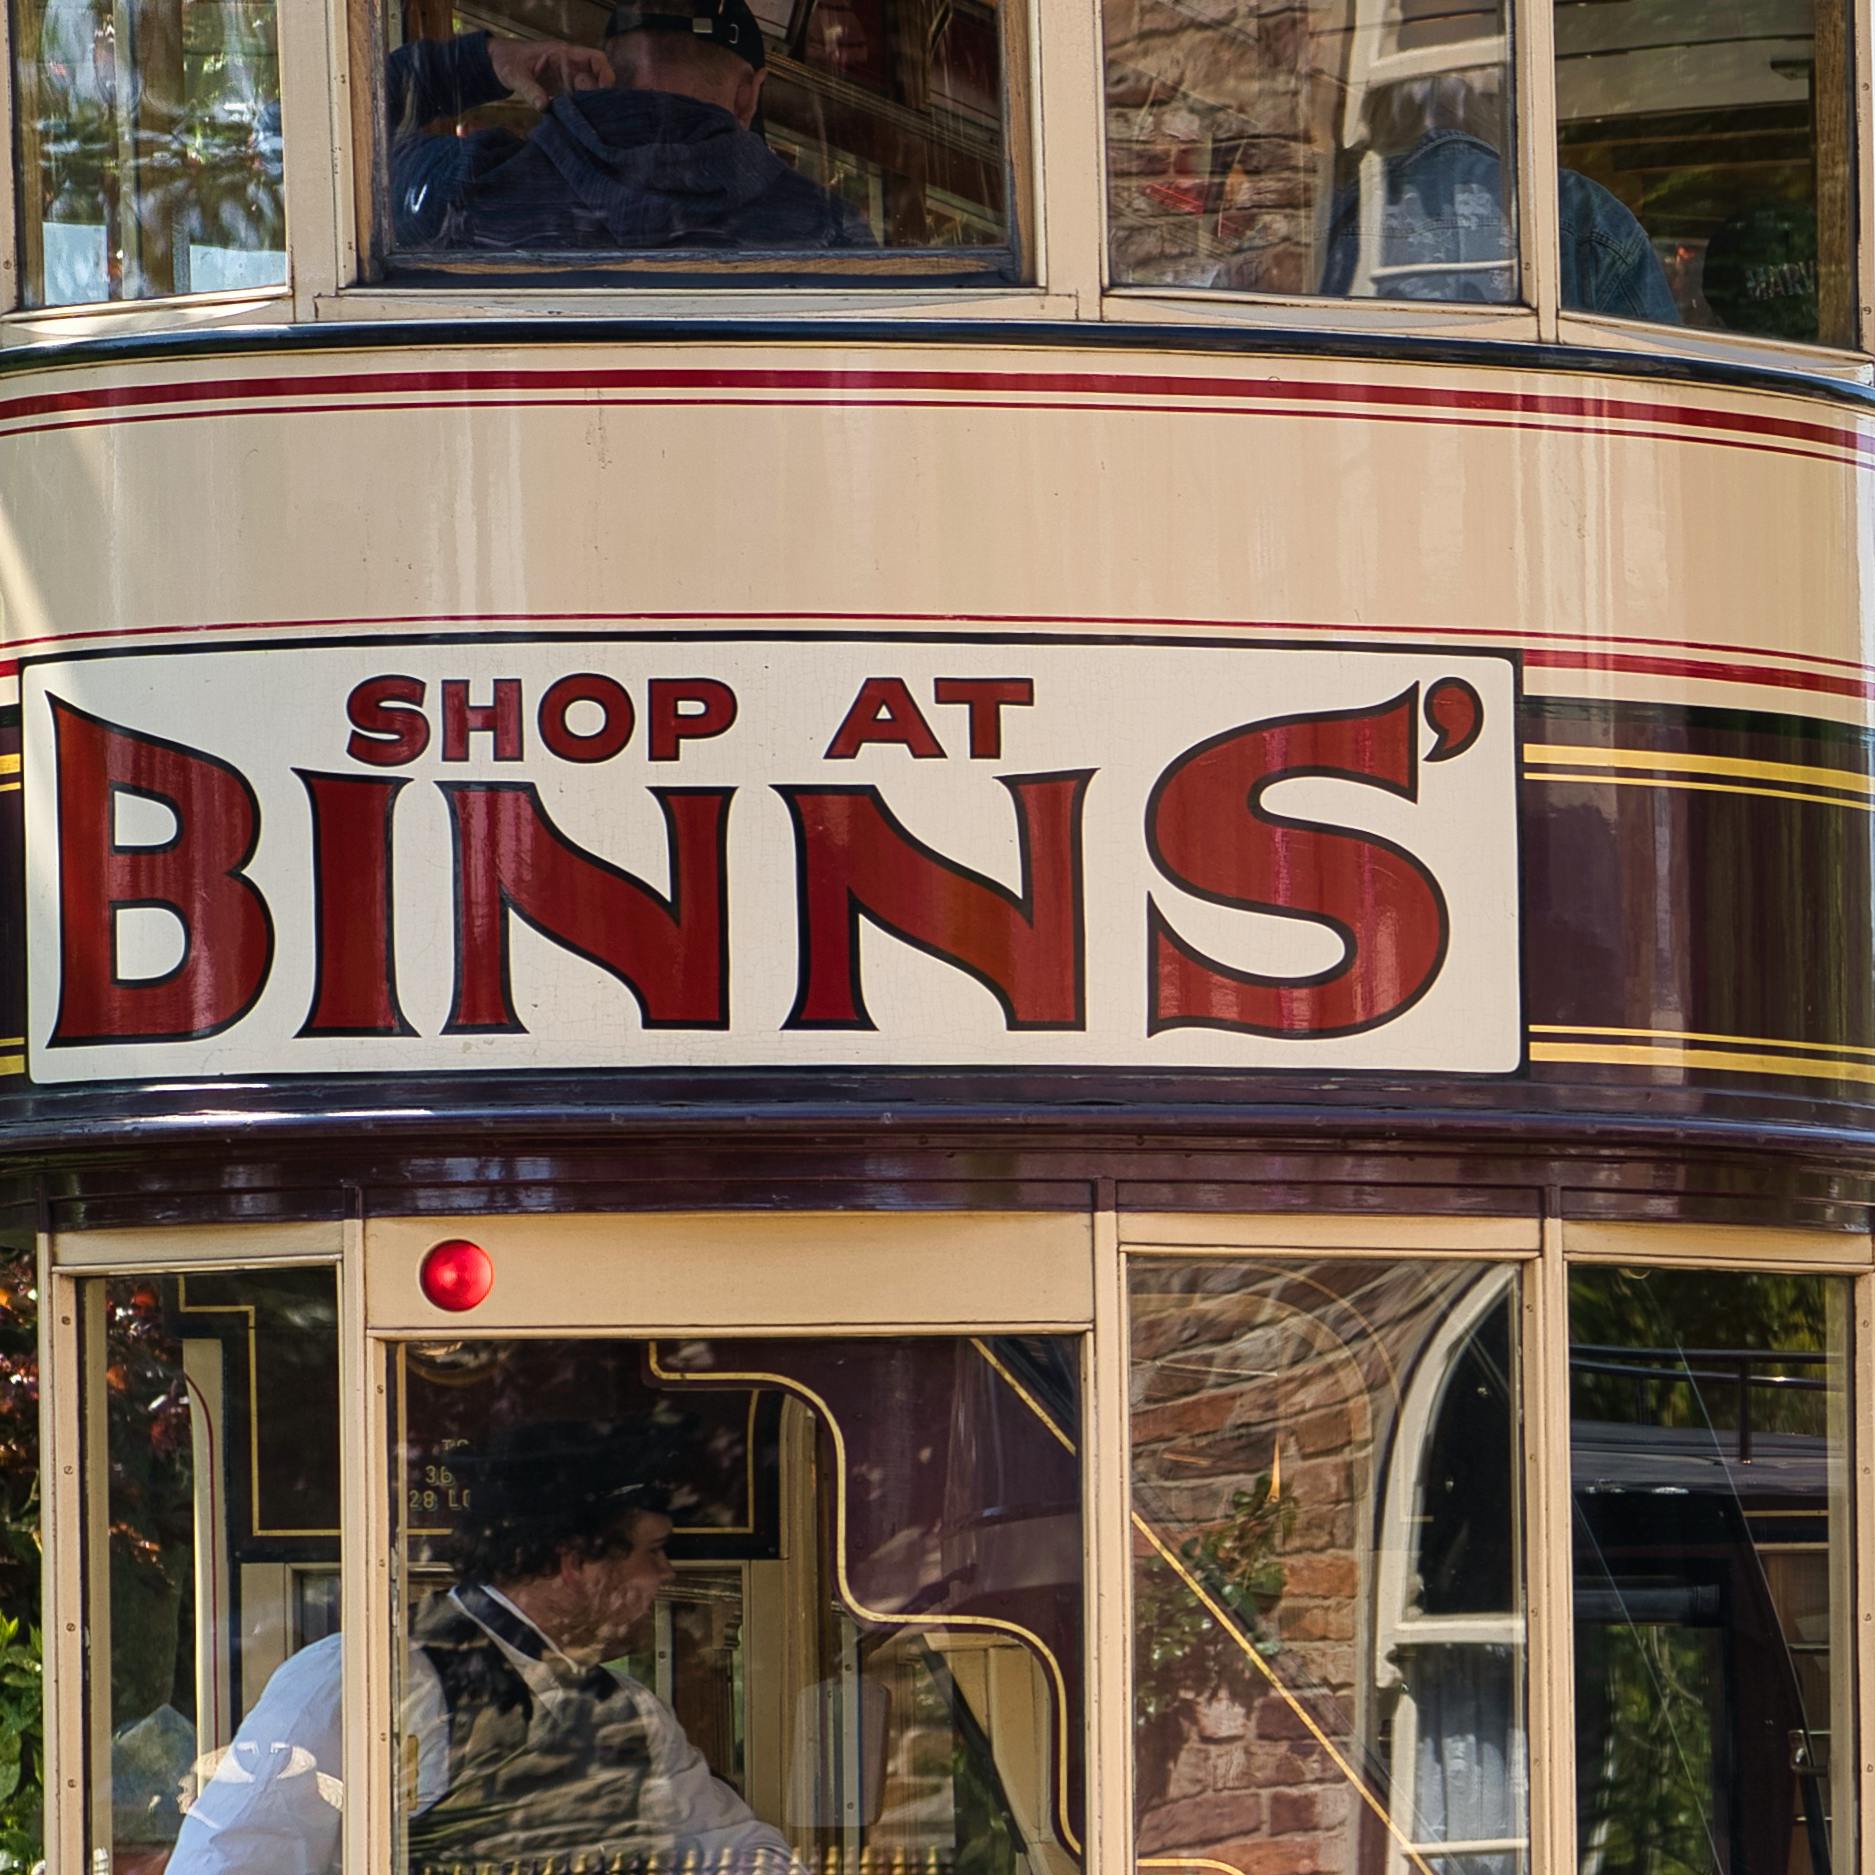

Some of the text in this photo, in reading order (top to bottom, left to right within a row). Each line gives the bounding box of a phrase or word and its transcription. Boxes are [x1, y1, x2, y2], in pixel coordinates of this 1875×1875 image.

[343, 671, 1036, 769] SHOP AT
[44, 674, 1486, 1048] BINNS'
[409, 1489, 439, 1512] 28
[425, 1464, 456, 1487] 36
